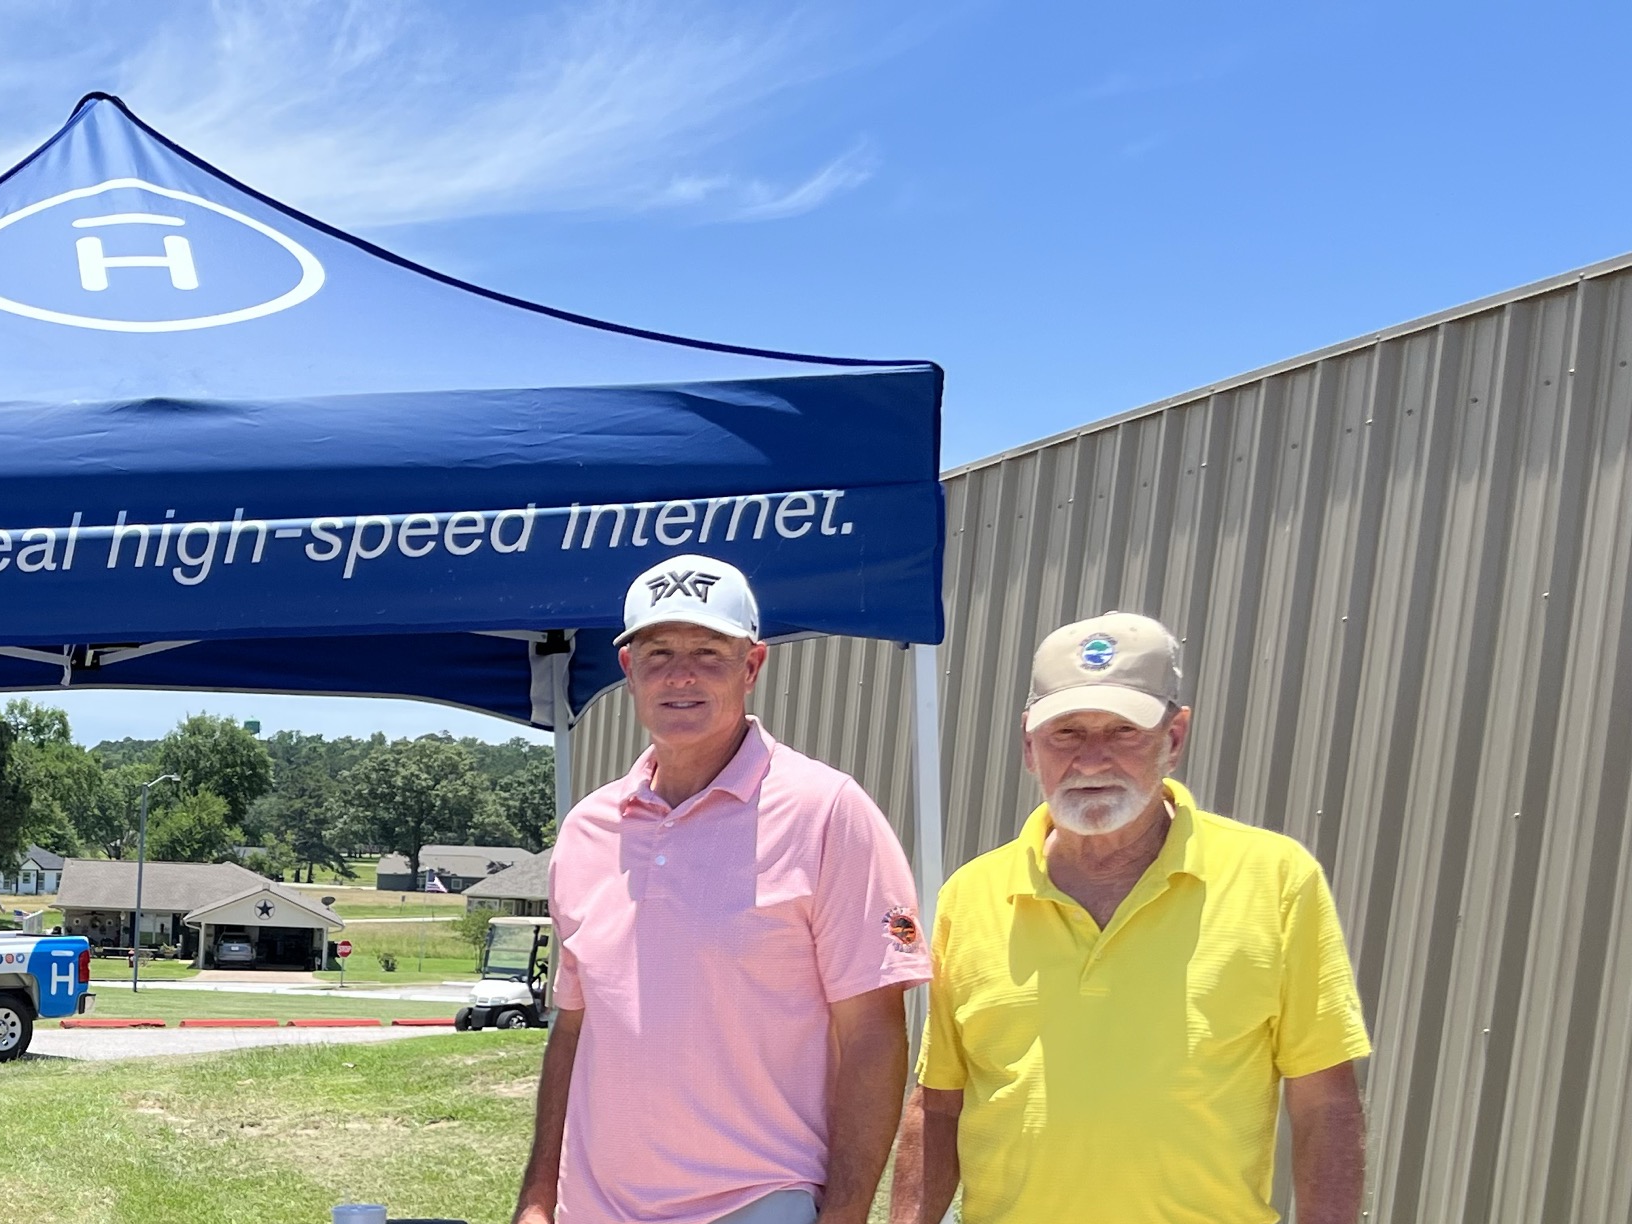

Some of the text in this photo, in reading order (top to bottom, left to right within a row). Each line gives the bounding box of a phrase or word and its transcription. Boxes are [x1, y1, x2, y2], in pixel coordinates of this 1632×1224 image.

[106, 502, 536, 586] high-speed
[561, 489, 853, 551] internet.
[645, 570, 721, 608] PXG
[50, 962, 75, 996] H
